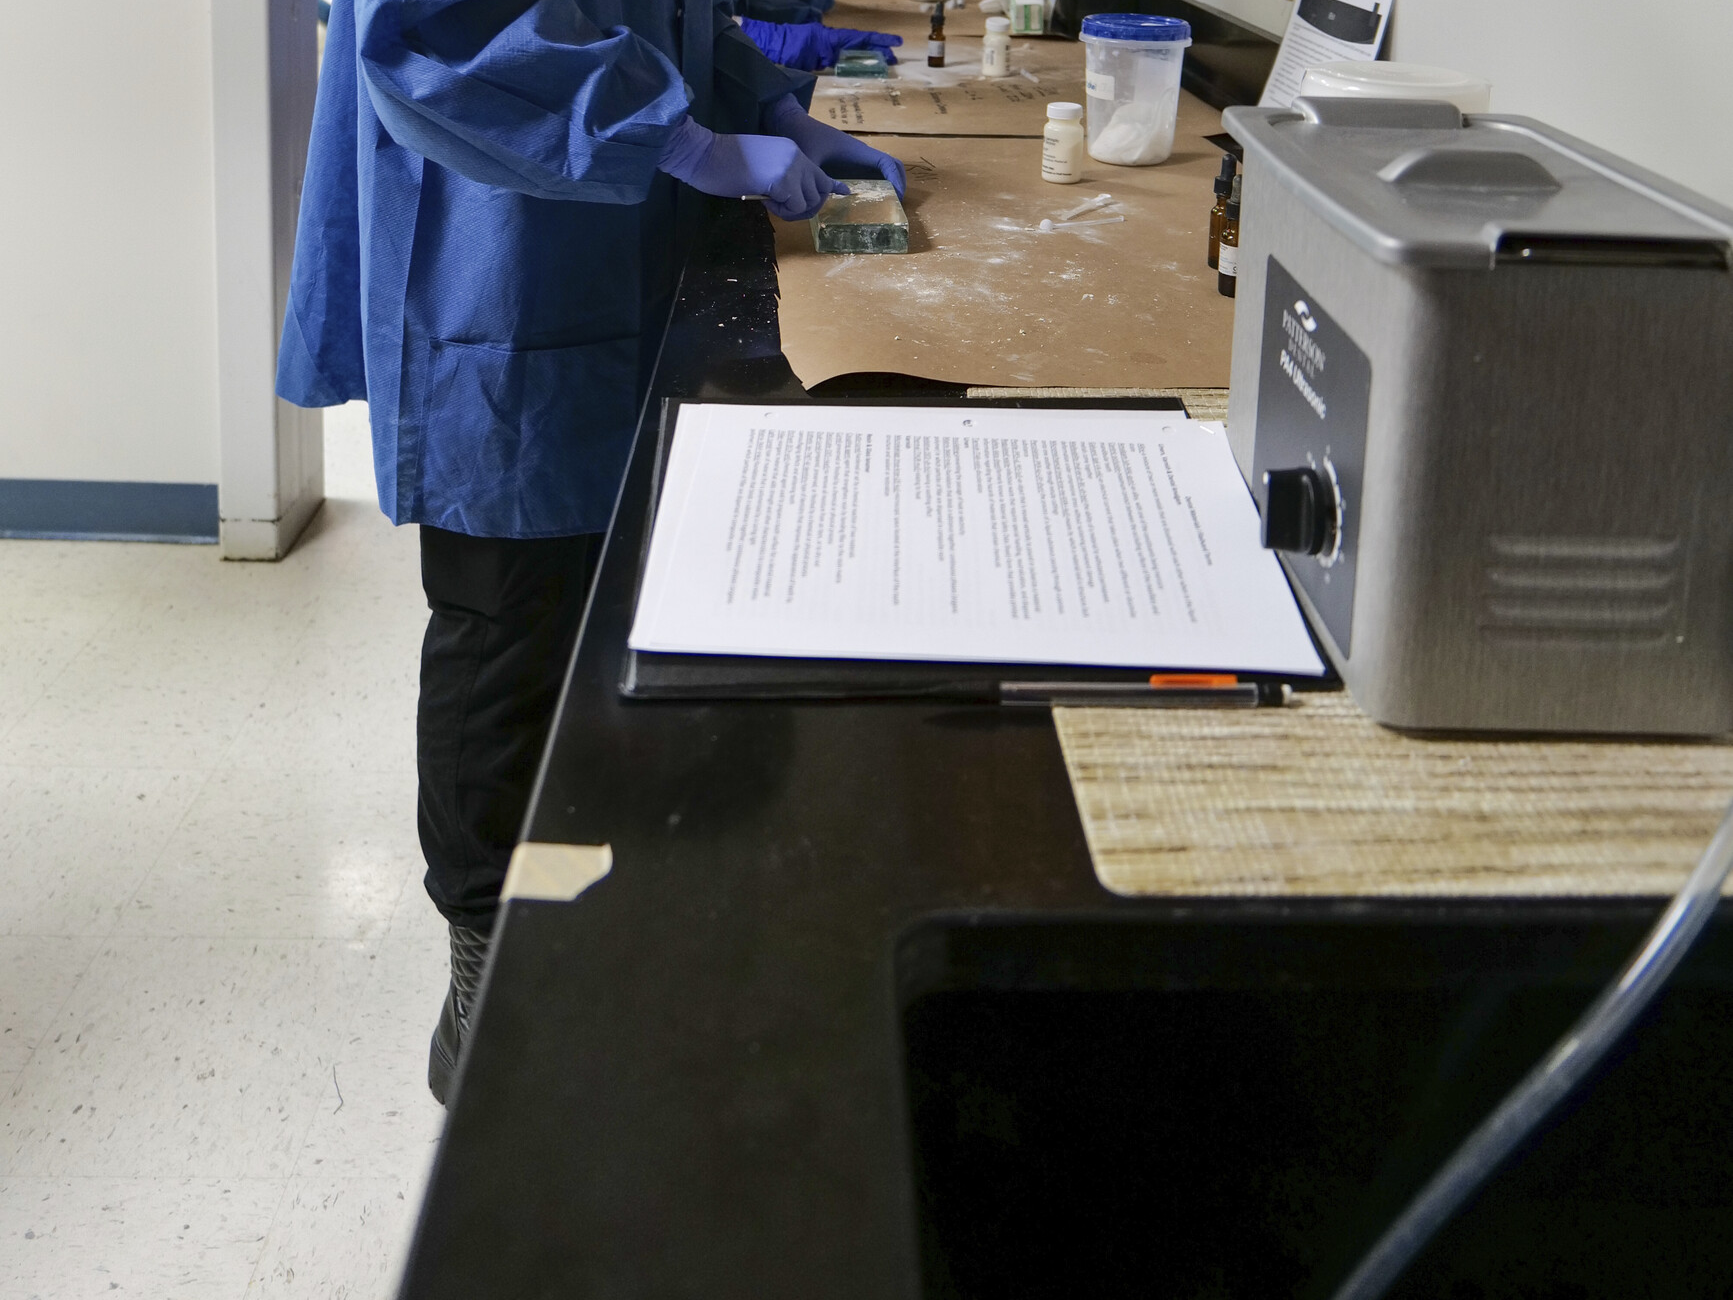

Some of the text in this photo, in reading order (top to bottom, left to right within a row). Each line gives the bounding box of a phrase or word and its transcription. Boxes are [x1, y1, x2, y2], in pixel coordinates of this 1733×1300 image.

[1282, 309, 1326, 373] PATTERSON
[1288, 337, 1315, 379] DENTAL
[1292, 365, 1326, 420] Ultrasonic
